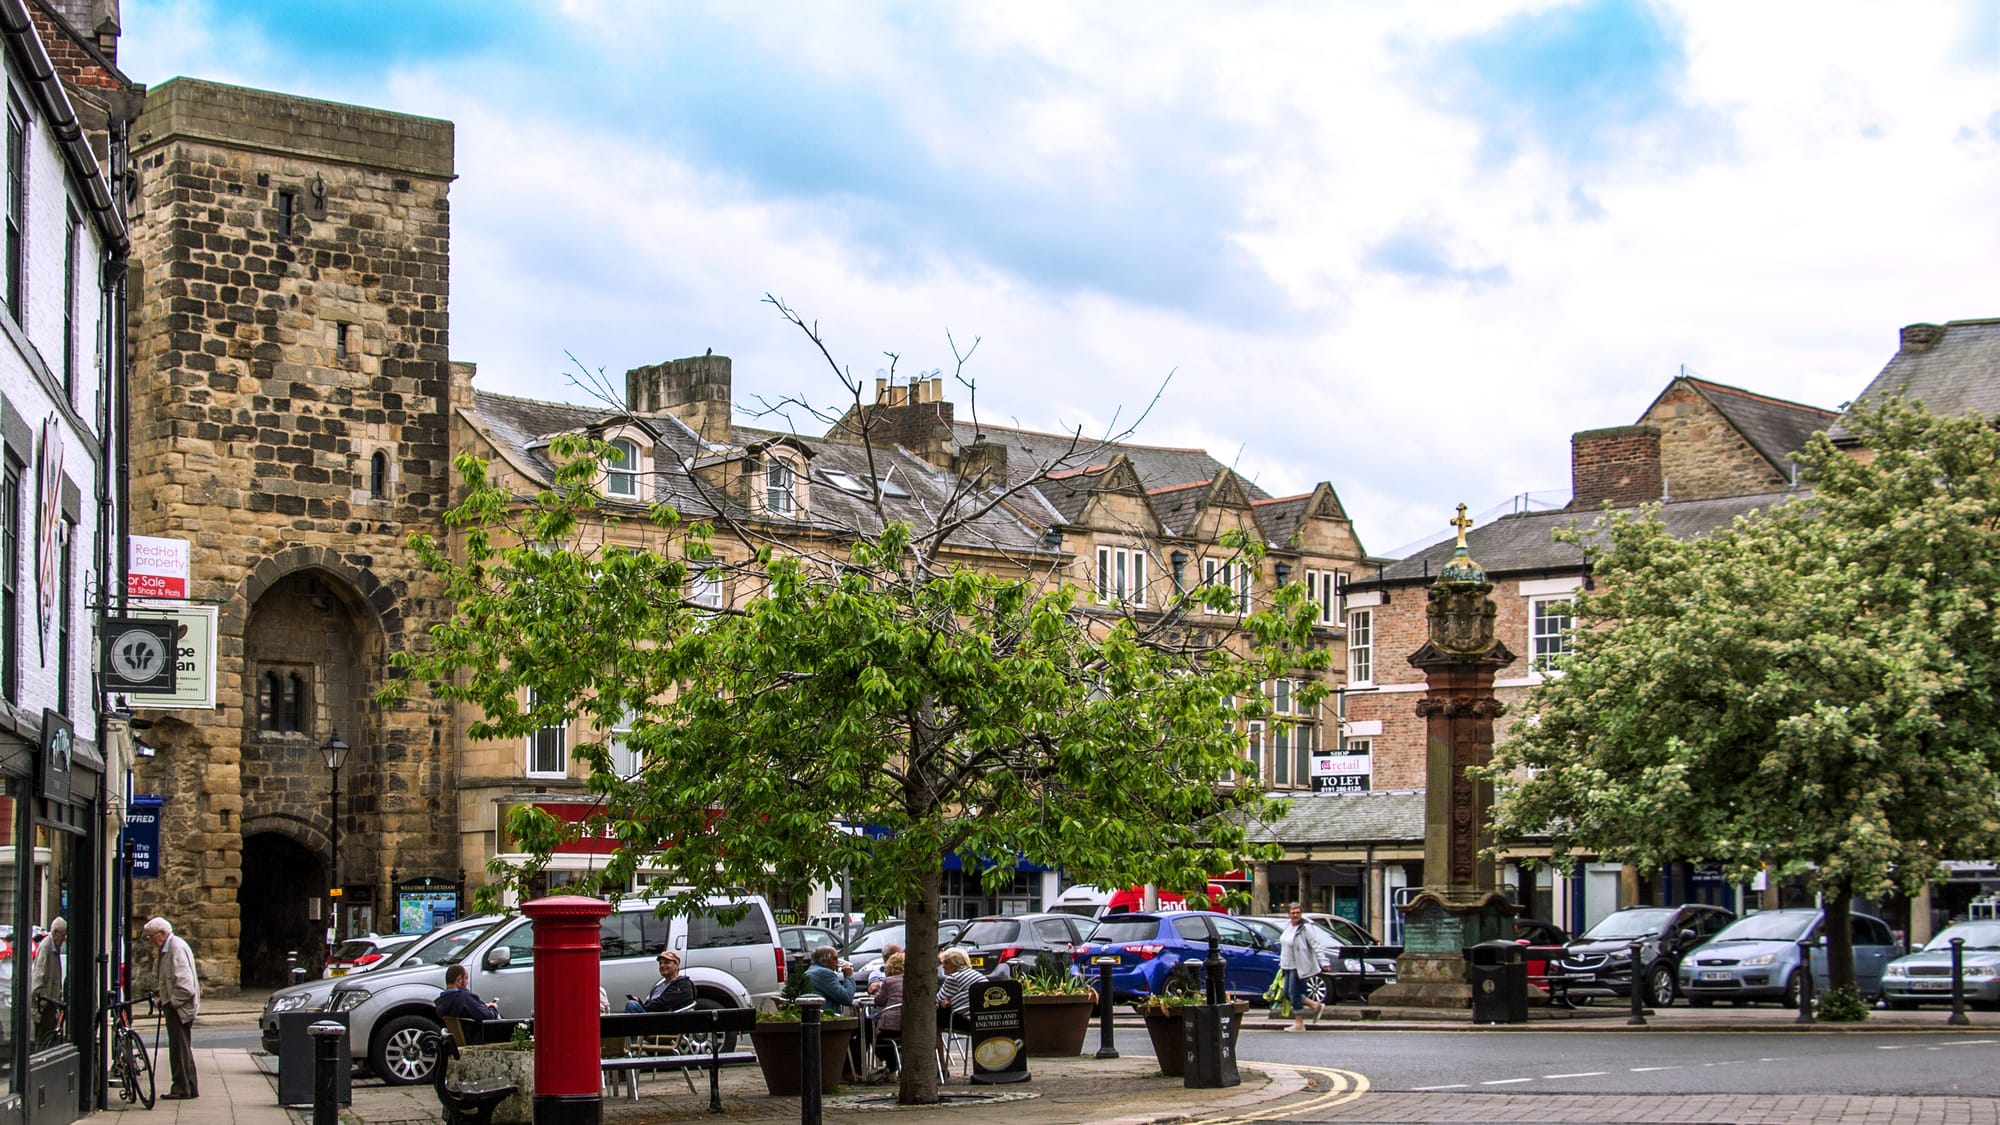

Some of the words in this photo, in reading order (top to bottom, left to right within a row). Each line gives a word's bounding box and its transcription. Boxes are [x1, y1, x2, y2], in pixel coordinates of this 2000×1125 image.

[135, 543, 178, 557] RedHot
[135, 557, 185, 571] property
[128, 577, 138, 586] or
[141, 575, 166, 587] Sale
[137, 587, 157, 597] Shop
[165, 589, 181, 597] Flats
[176, 661, 195, 672] an
[1320, 777, 1337, 786] TO
[1340, 776, 1361, 786] LET
[126, 815, 155, 823] TFRED
[133, 860, 150, 869] ing
[1139, 898, 1187, 912] Iland
[775, 913, 795, 924] SUN
[977, 1013, 1002, 1021] BREWED
[1003, 1012, 1017, 1020] AND
[975, 1020, 1001, 1028] ENJOYED
